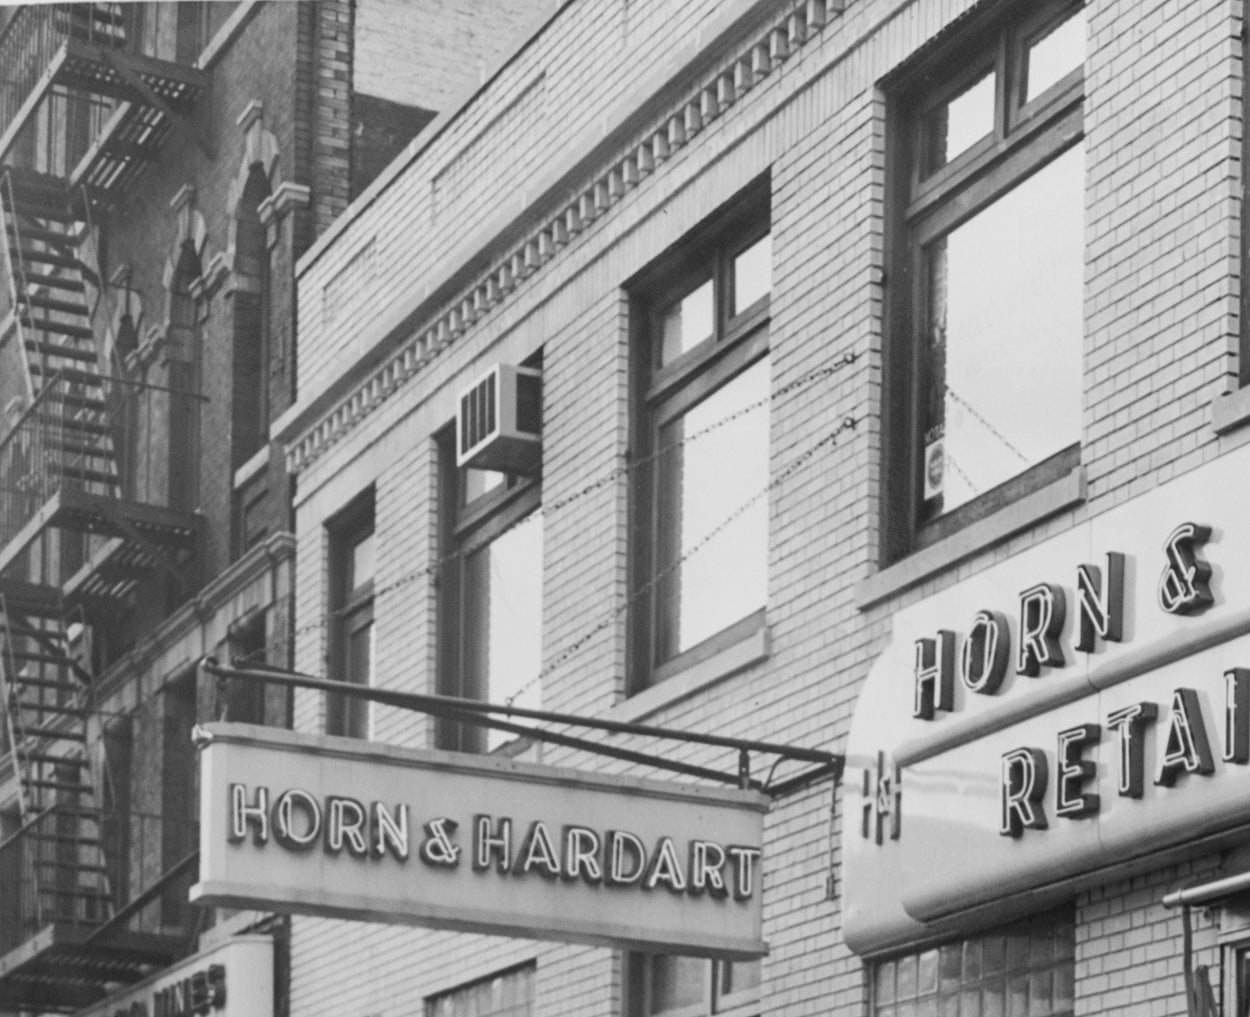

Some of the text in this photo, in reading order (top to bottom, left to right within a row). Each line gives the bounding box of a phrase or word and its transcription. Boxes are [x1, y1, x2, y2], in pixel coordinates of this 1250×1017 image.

[914, 550, 1126, 721] HORN
[1160, 521, 1215, 614] &
[228, 783, 761, 903] HORN & HARDART
